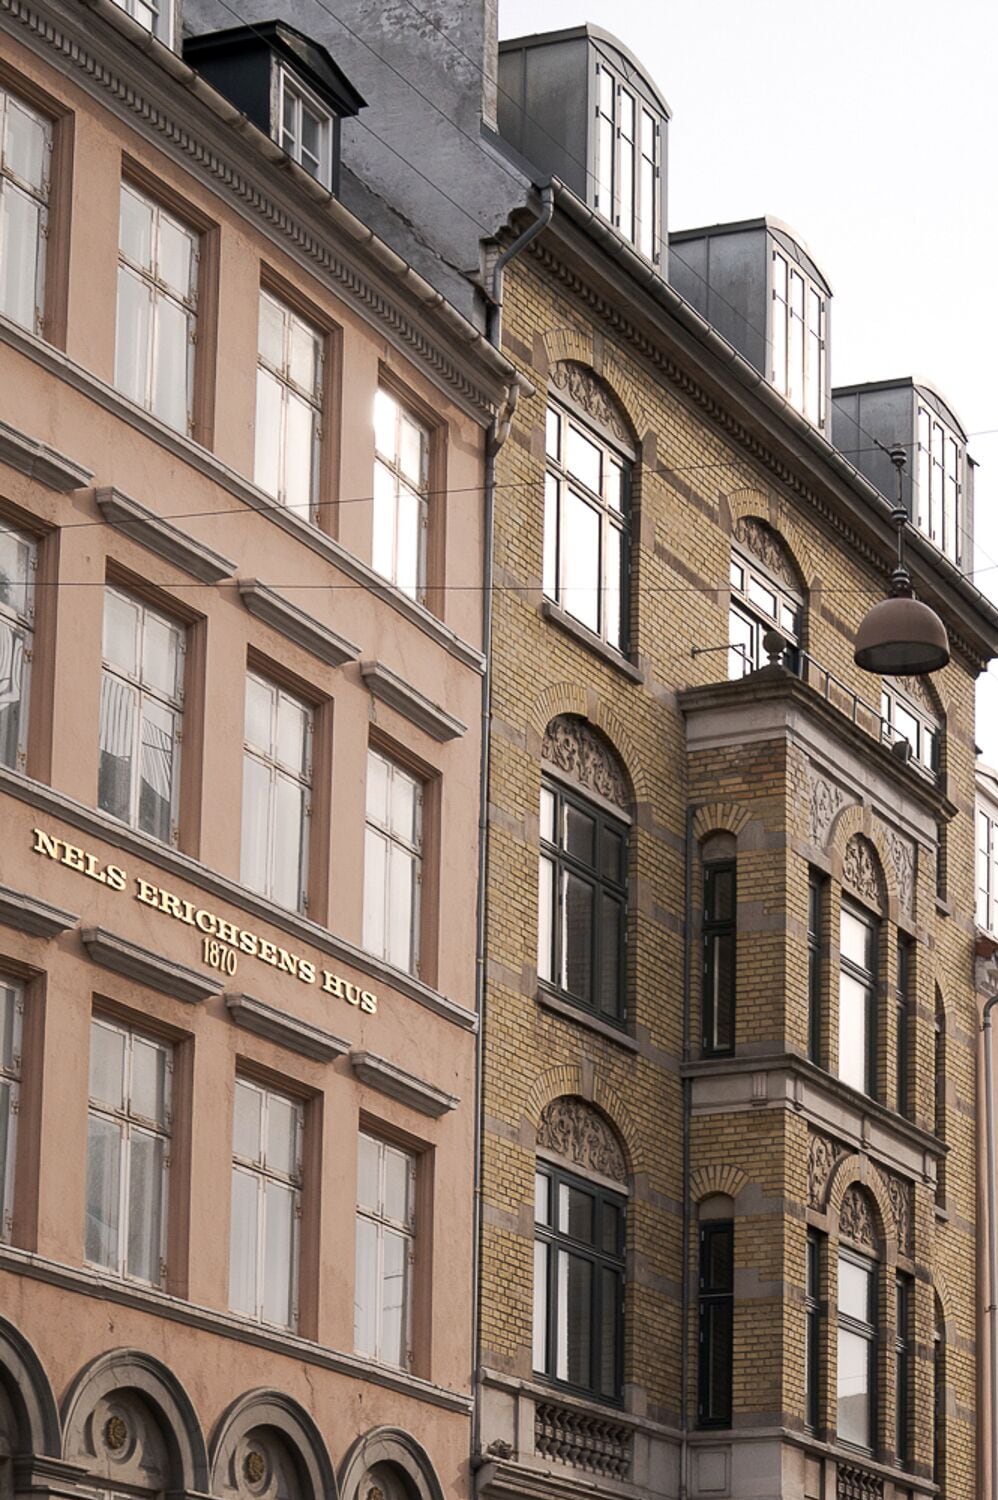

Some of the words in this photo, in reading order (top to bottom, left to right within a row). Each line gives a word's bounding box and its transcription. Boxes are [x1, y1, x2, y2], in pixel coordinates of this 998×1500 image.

[33, 828, 127, 892] NELS
[135, 877, 317, 985] ERICHSENS
[322, 969, 378, 1015] HUS
[202, 937, 238, 977] 1870
